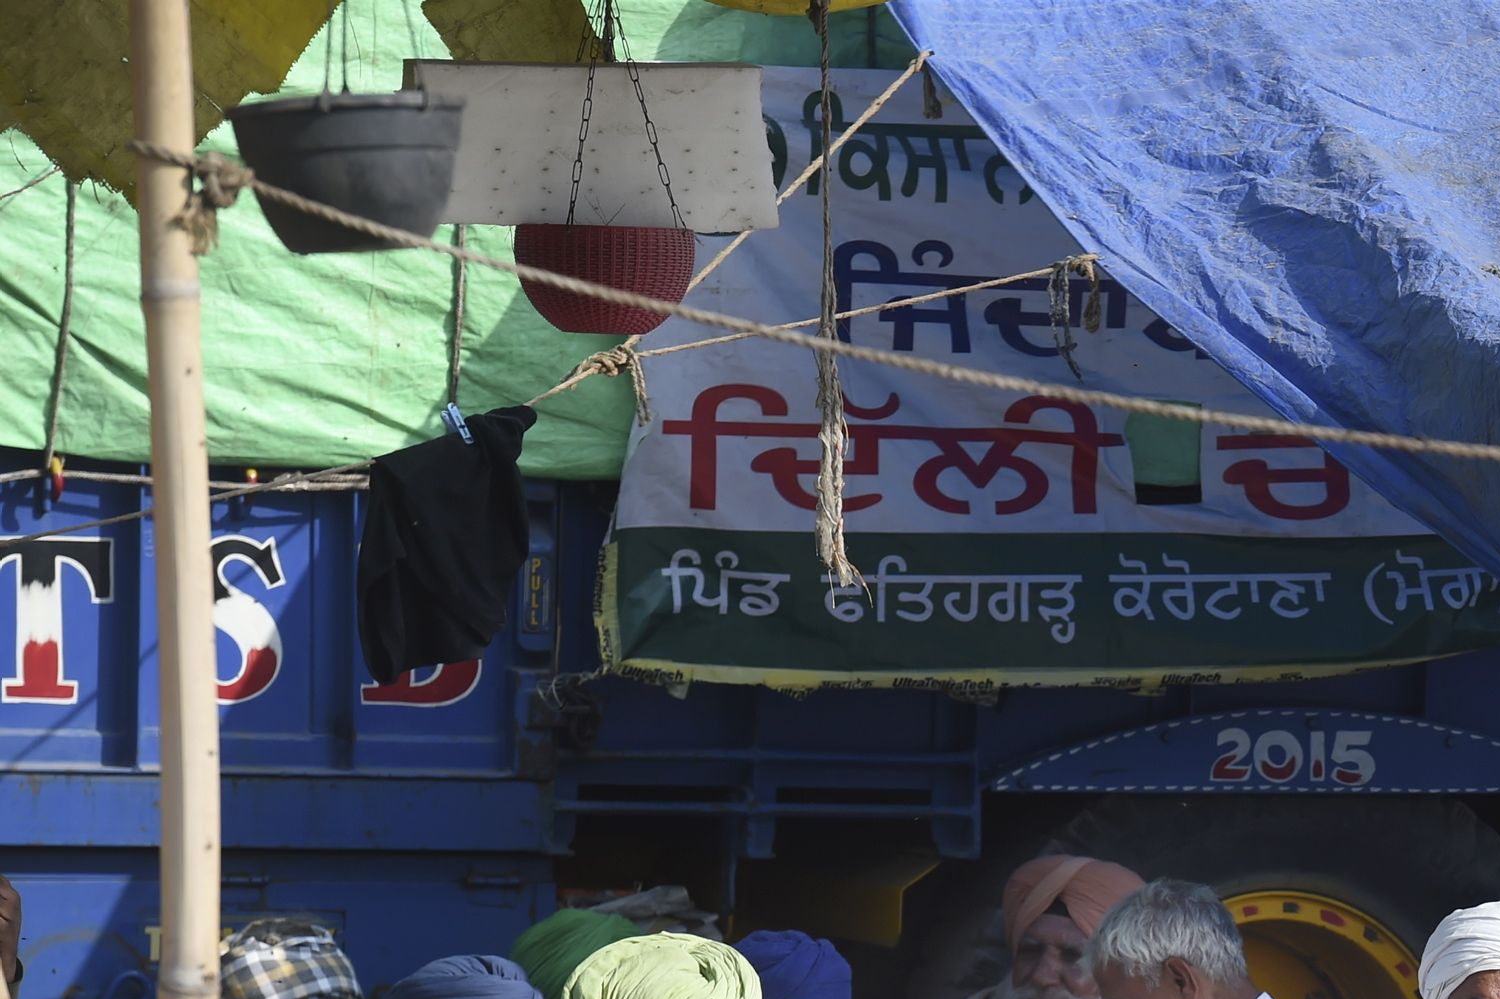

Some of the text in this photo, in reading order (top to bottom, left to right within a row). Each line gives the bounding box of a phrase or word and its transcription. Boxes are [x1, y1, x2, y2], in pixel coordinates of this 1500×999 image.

[833, 240, 1211, 360] ਜਿੰਦਾ
[662, 383, 1124, 515] ਦਿੱਲੀ
[530, 557, 543, 625] PULL
[661, 548, 791, 617] ਪਿੰਡ
[1160, 670, 1221, 687] UltraTech
[1209, 727, 1376, 786] 2015
